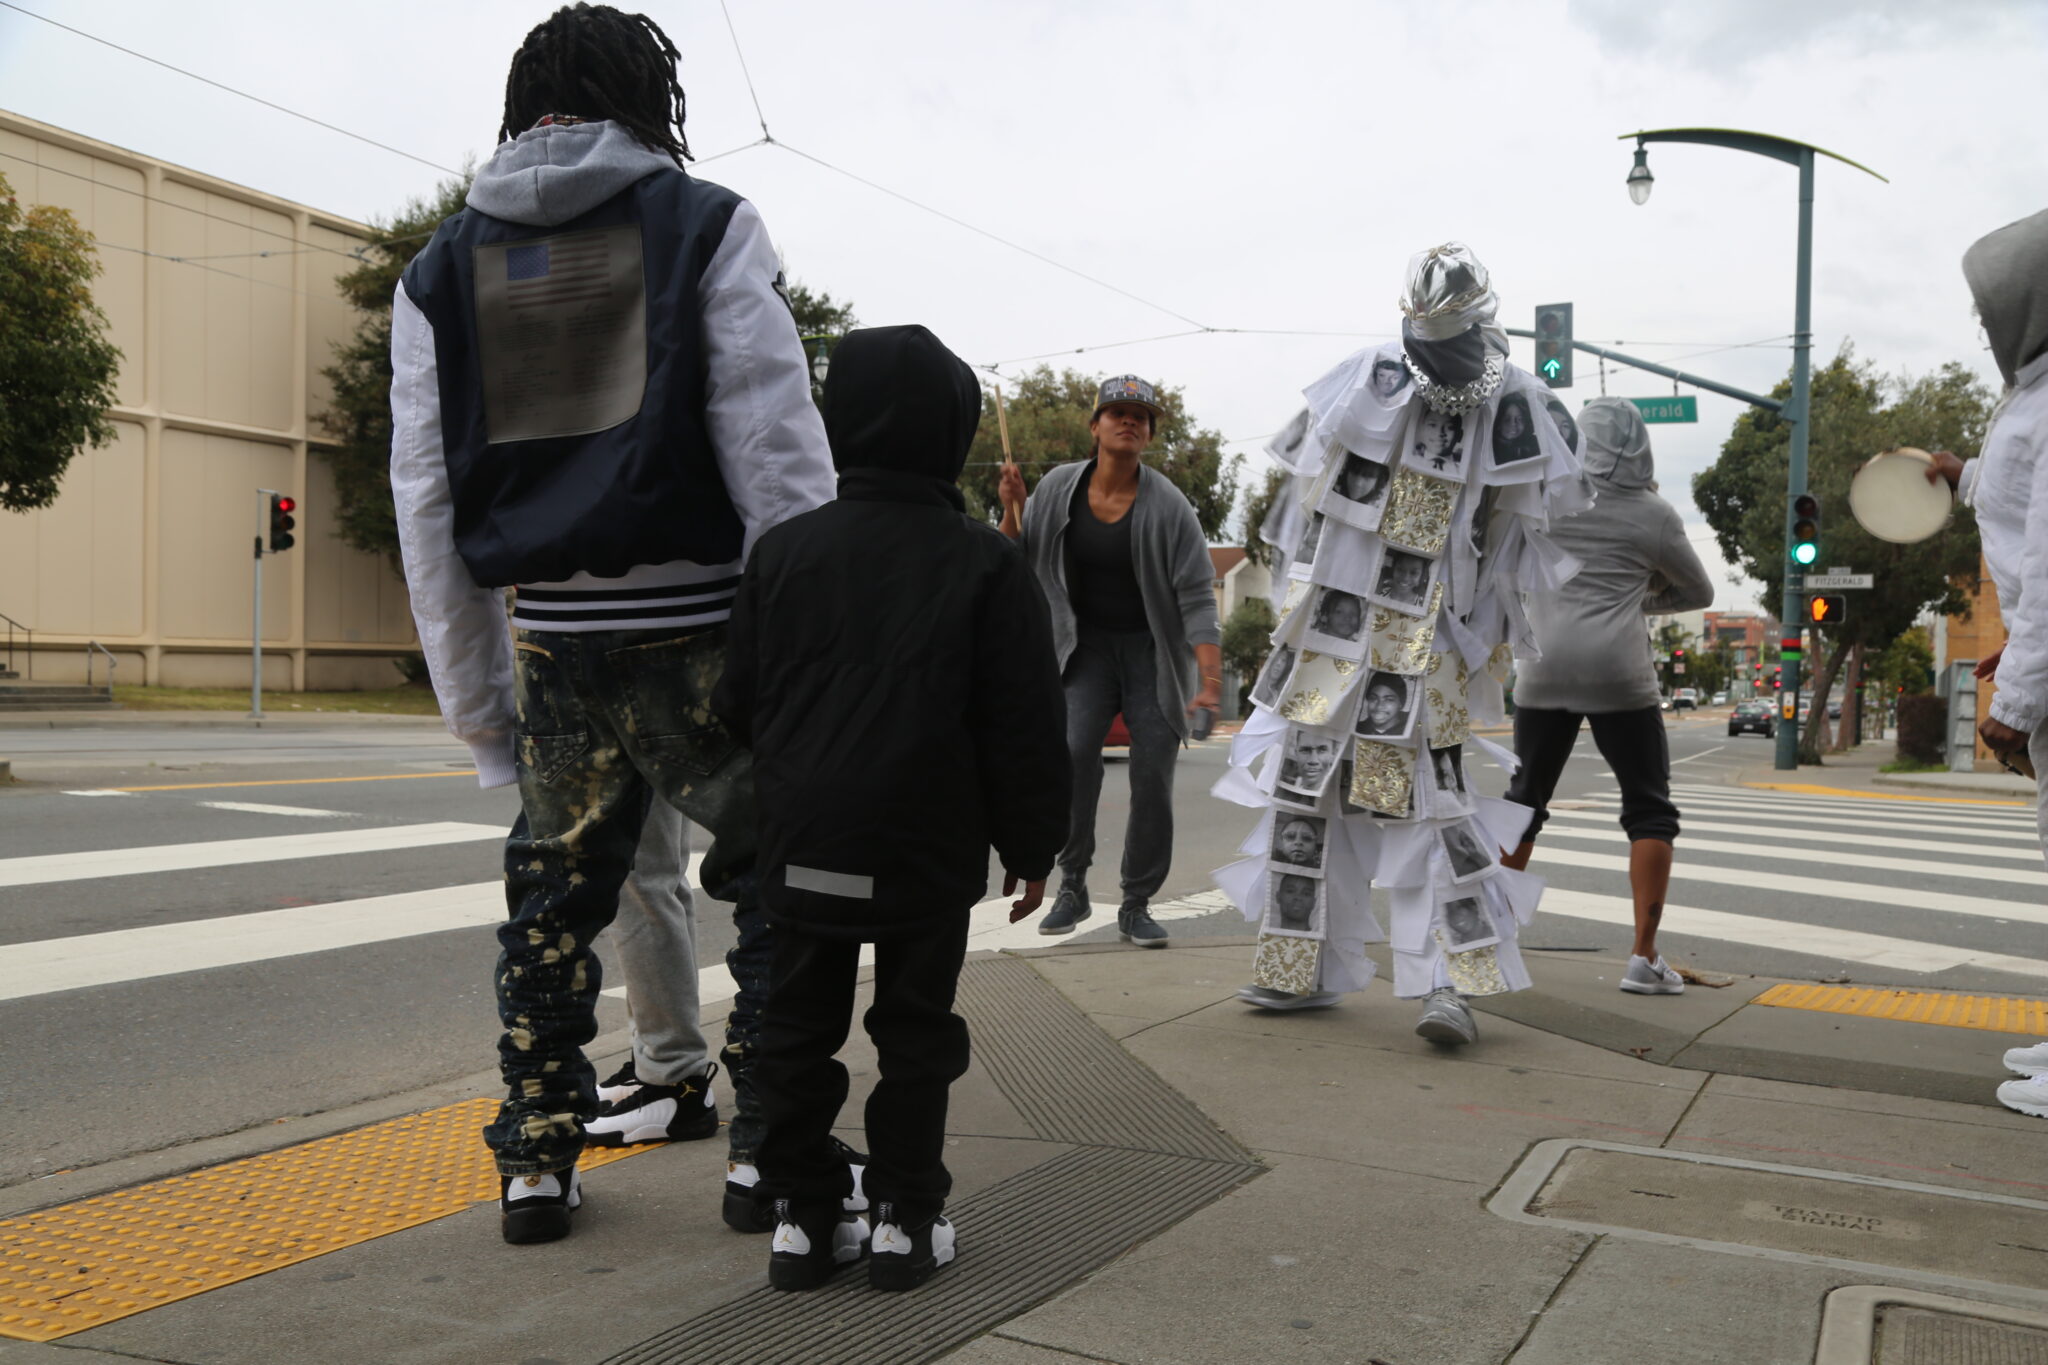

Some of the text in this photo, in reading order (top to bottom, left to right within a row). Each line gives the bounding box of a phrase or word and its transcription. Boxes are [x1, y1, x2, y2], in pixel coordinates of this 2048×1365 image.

[1815, 575, 1864, 586] FITZGERALD
[1771, 1204, 1883, 1226] TRAFFIC
[1781, 1213, 1882, 1232] SIGNAL
